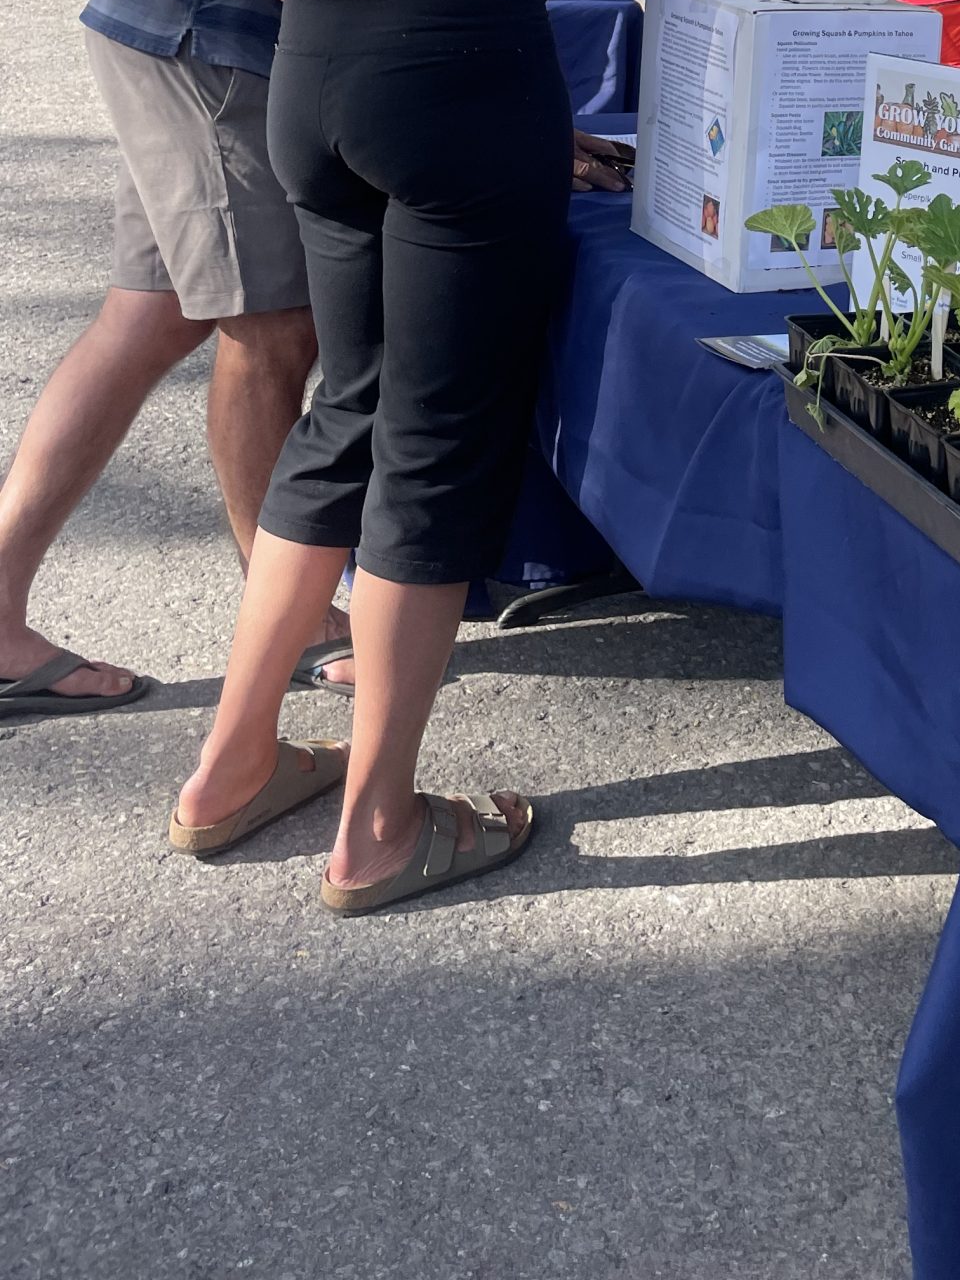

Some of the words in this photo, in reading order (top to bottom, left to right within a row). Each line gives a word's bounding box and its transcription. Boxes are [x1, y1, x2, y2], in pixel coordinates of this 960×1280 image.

[792, 30, 820, 39] Growing
[821, 29, 847, 39] Squash
[853, 30, 886, 39] Pumpkins
[878, 103, 928, 127] GROW
[876, 125, 937, 150] Community
[932, 165, 950, 176] and
[901, 251, 922, 262] Small
